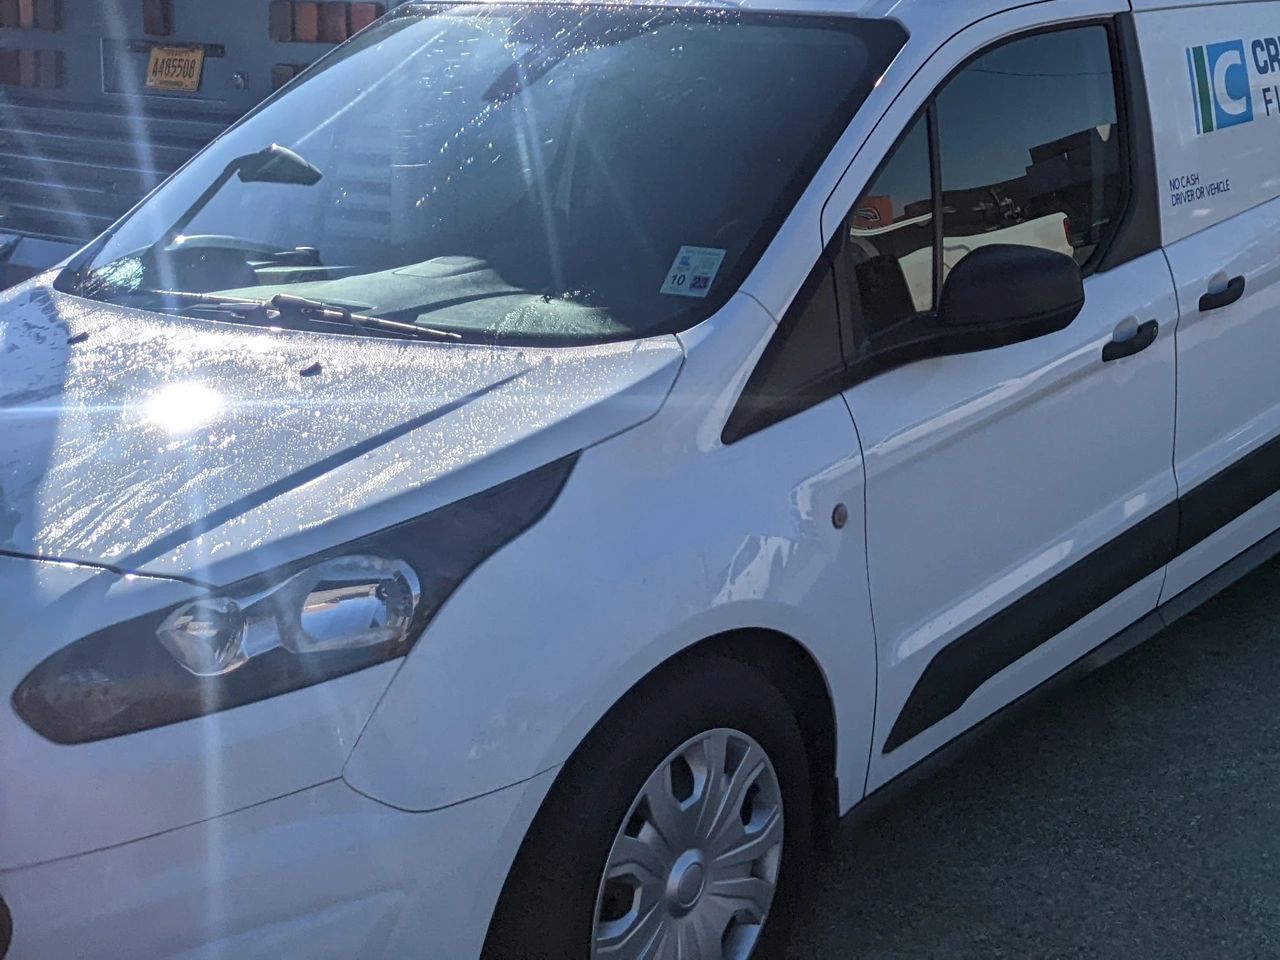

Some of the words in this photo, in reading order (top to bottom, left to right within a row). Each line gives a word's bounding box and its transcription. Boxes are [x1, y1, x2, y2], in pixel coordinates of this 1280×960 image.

[1169, 177, 1181, 191] NO
[1180, 171, 1200, 188] CASH
[1171, 189, 1196, 206] DRIVER
[1195, 185, 1206, 200] OR
[1205, 178, 1231, 196] VEHICLE
[671, 273, 686, 286] 10
